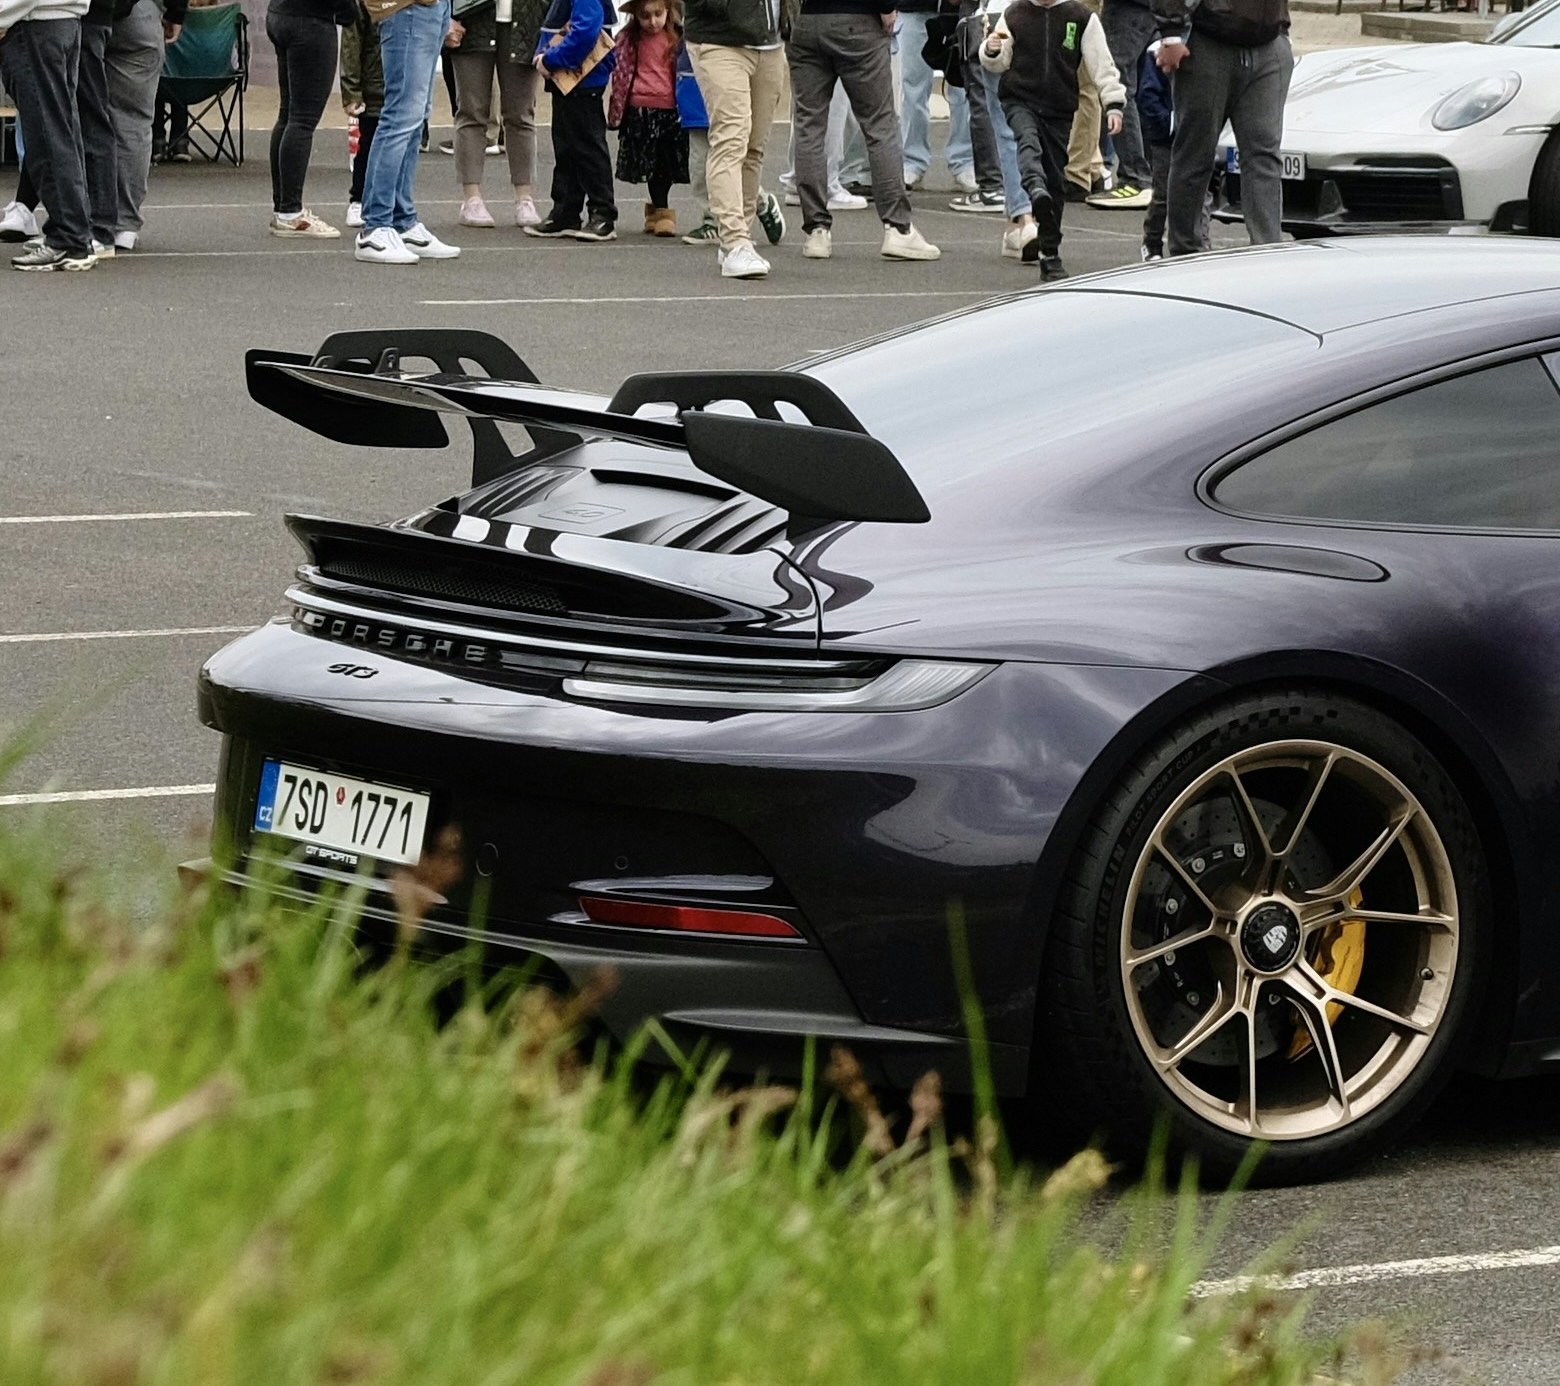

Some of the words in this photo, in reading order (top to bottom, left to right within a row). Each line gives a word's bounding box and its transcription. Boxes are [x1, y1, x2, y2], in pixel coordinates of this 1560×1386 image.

[303, 612, 487, 663] PORSCHE
[327, 663, 379, 679] GT3
[1145, 767, 1174, 804] SPORT
[1176, 750, 1194, 770] CUP
[259, 805, 272, 822] CZ
[276, 773, 329, 835] 7SD
[350, 790, 413, 855] 1771
[318, 847, 358, 865] SPORTS
[1094, 844, 1126, 969] MICHELIN
